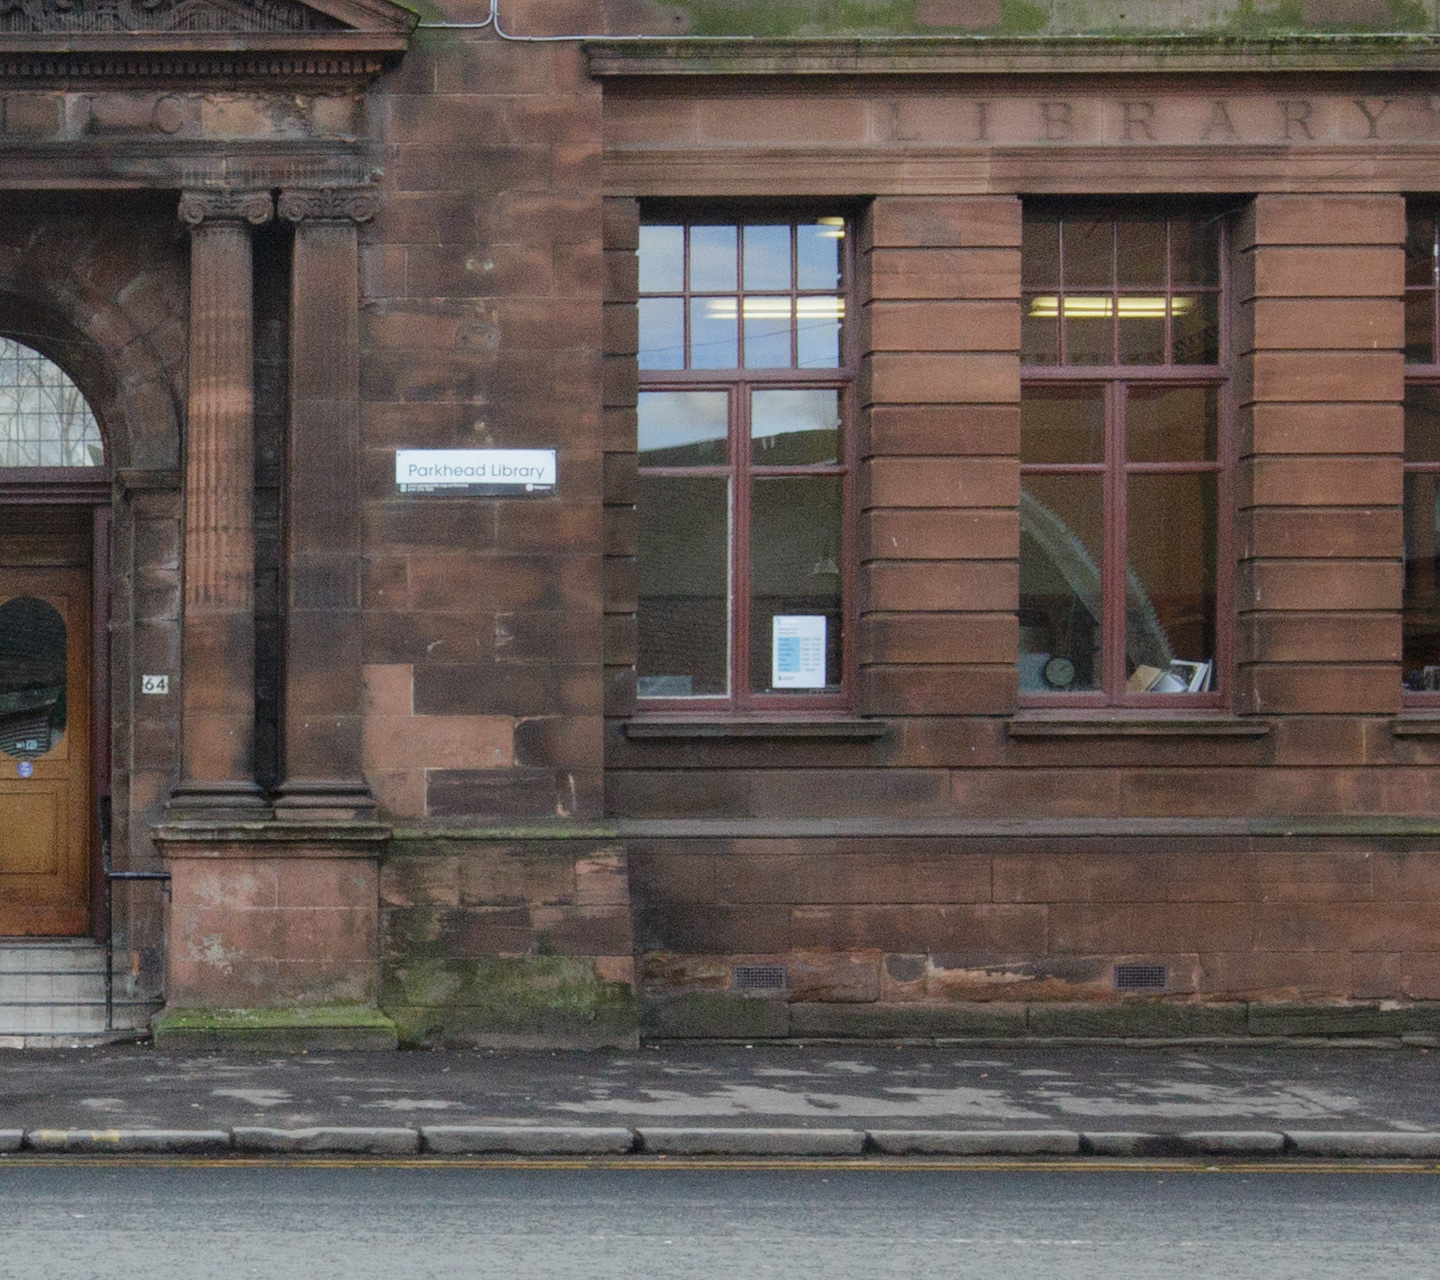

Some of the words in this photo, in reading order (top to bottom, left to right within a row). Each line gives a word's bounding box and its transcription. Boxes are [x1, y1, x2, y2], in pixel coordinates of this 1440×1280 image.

[888, 100, 1393, 141] LIBRARY
[408, 464, 485, 477] Parkhead
[491, 464, 545, 479] Library
[145, 678, 166, 691] 64
